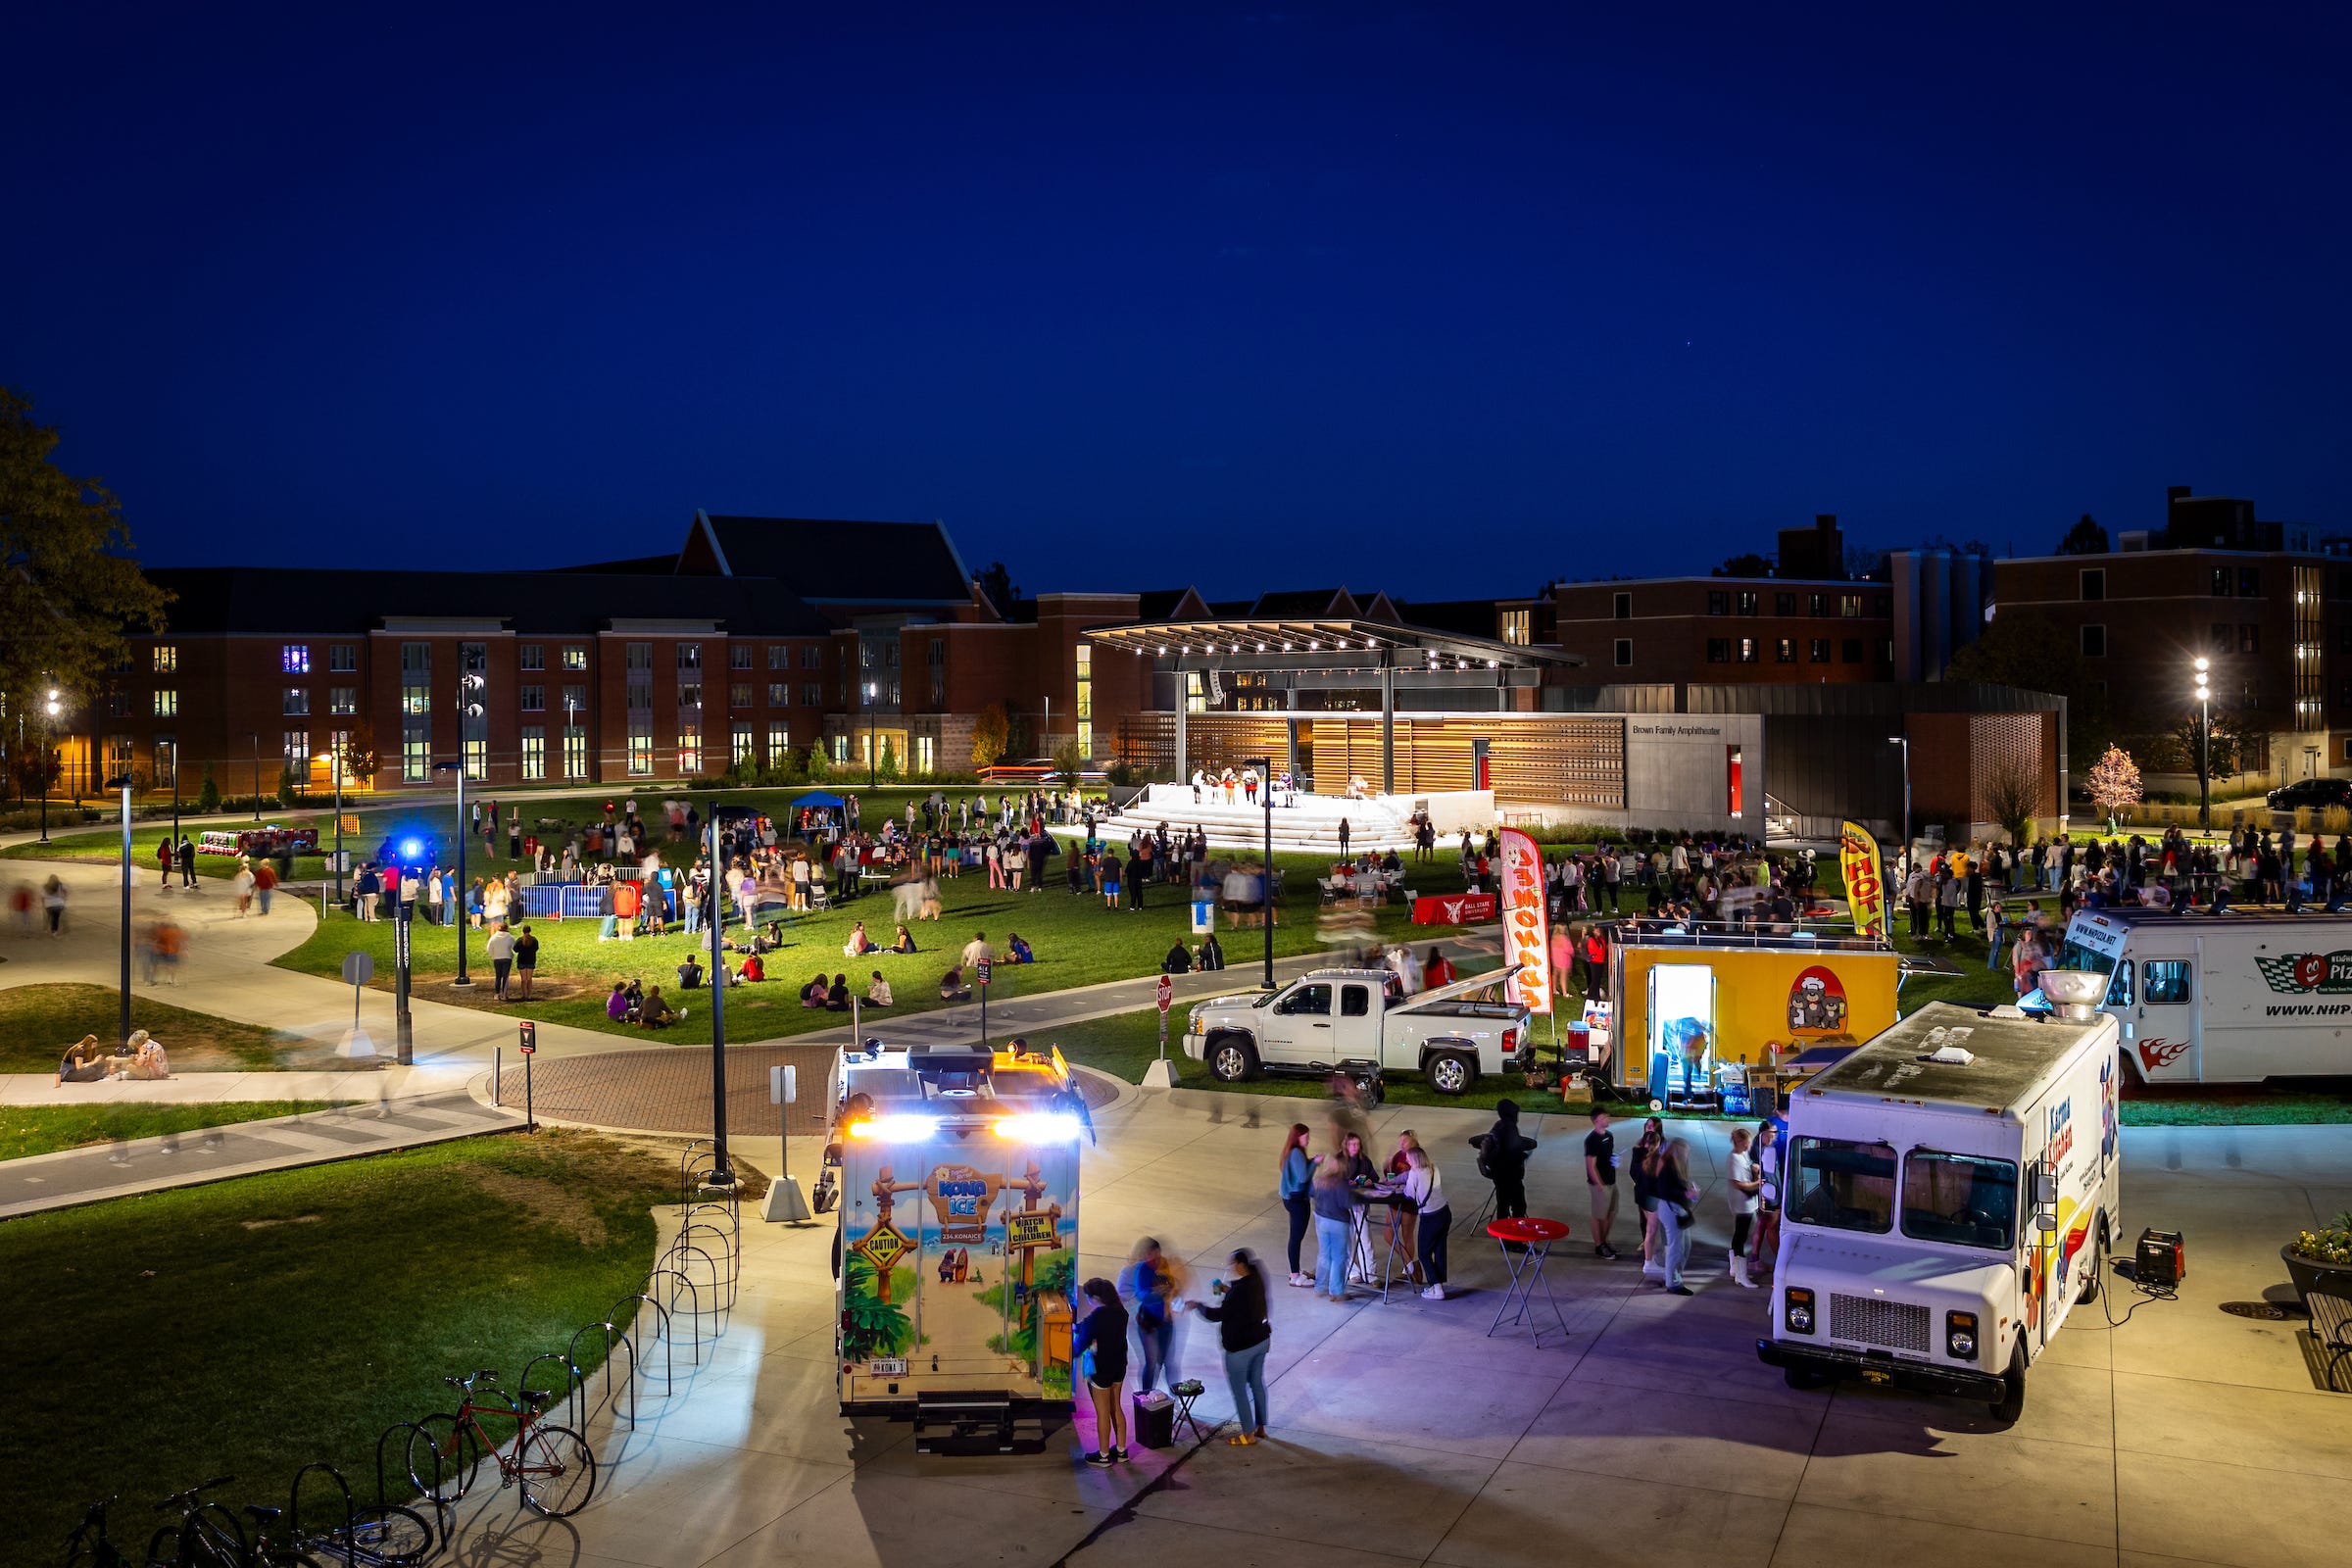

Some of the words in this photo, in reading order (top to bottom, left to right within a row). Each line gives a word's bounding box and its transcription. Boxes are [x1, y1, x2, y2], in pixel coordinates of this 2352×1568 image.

[1655, 726, 1676, 736] Family
[1677, 726, 1721, 736] Amphitheater
[2076, 923, 2117, 946] WWW.NHPIZZA.NET
[1157, 986, 1172, 1002] STOP
[2266, 1004, 2352, 1015] WWW.NHP
[2048, 1124, 2073, 1175] Kitchen
[938, 1180, 987, 1198] KONA
[949, 1198, 977, 1215] ICE
[1014, 1217, 1045, 1227] WATCH
[1023, 1225, 1039, 1234] FOR
[1012, 1231, 1052, 1243] CHILDREN
[869, 1238, 899, 1251] CAUTION
